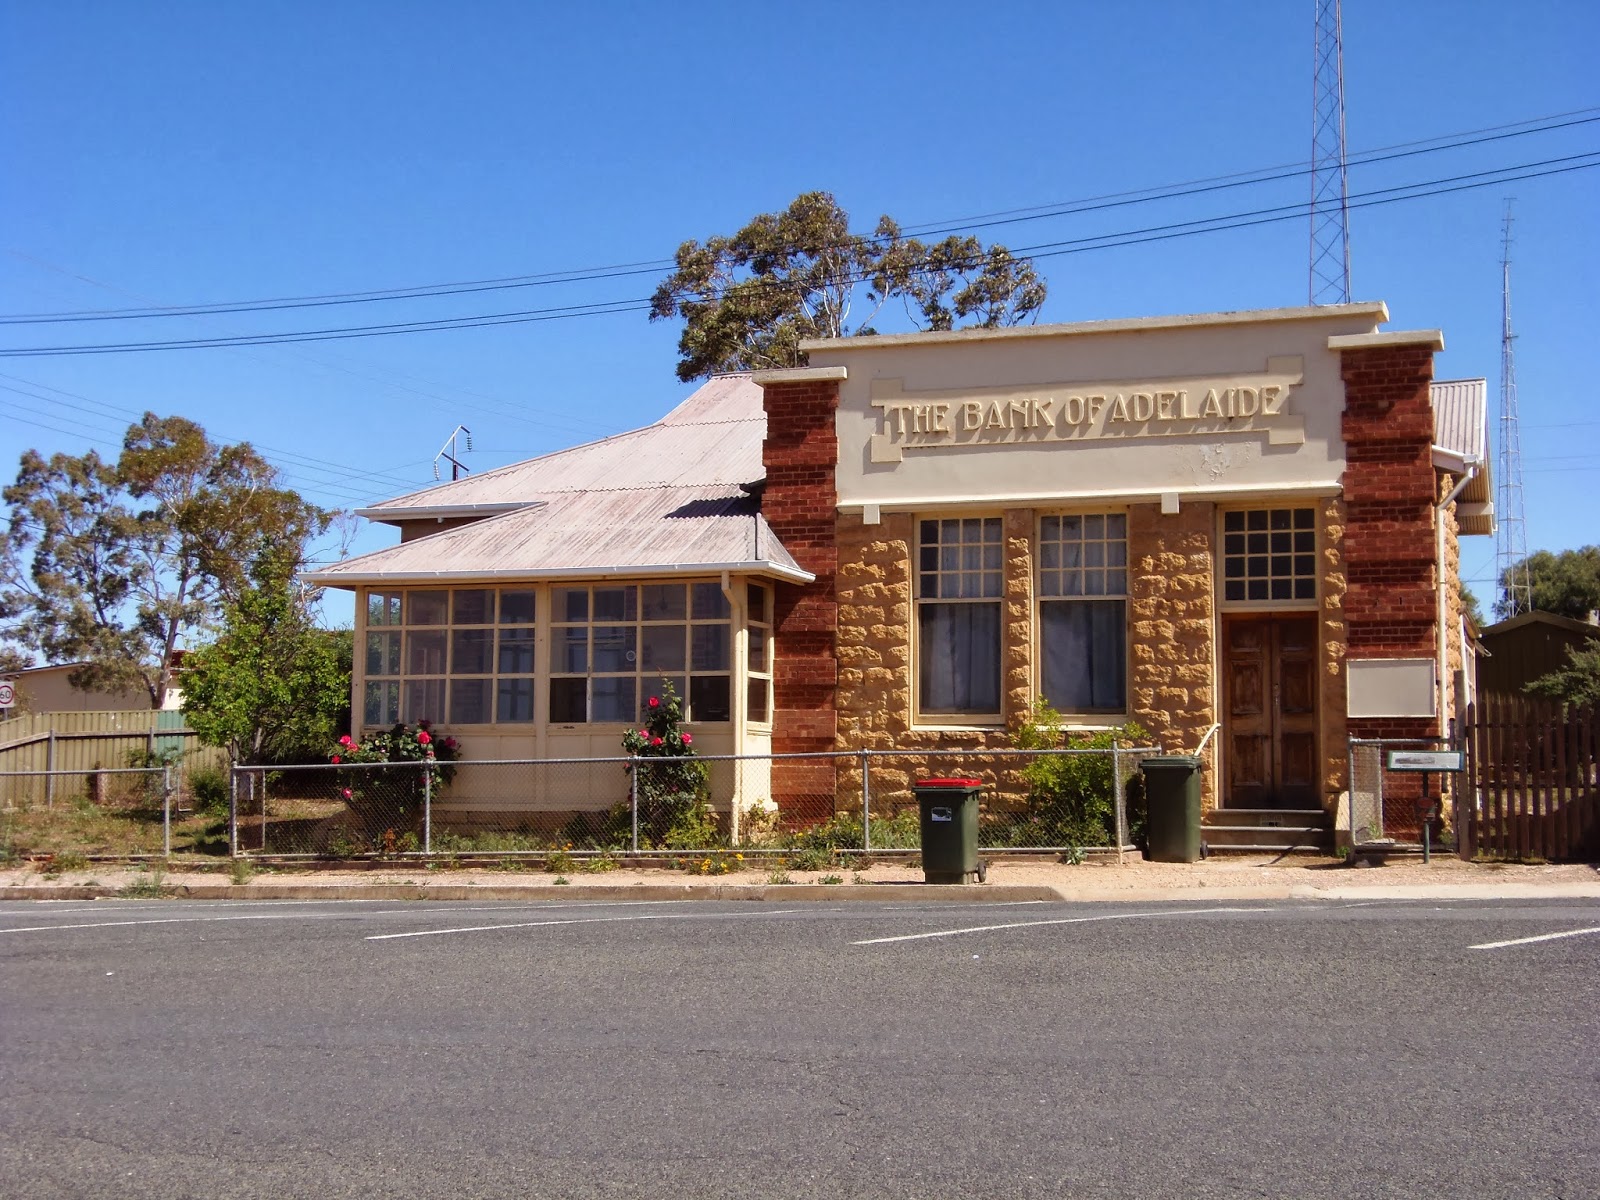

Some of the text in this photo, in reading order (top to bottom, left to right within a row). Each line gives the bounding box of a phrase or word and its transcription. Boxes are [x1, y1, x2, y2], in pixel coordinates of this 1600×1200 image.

[890, 384, 1282, 433] THE BANK OF ADELAIDE
[0, 690, 11, 699] 60
